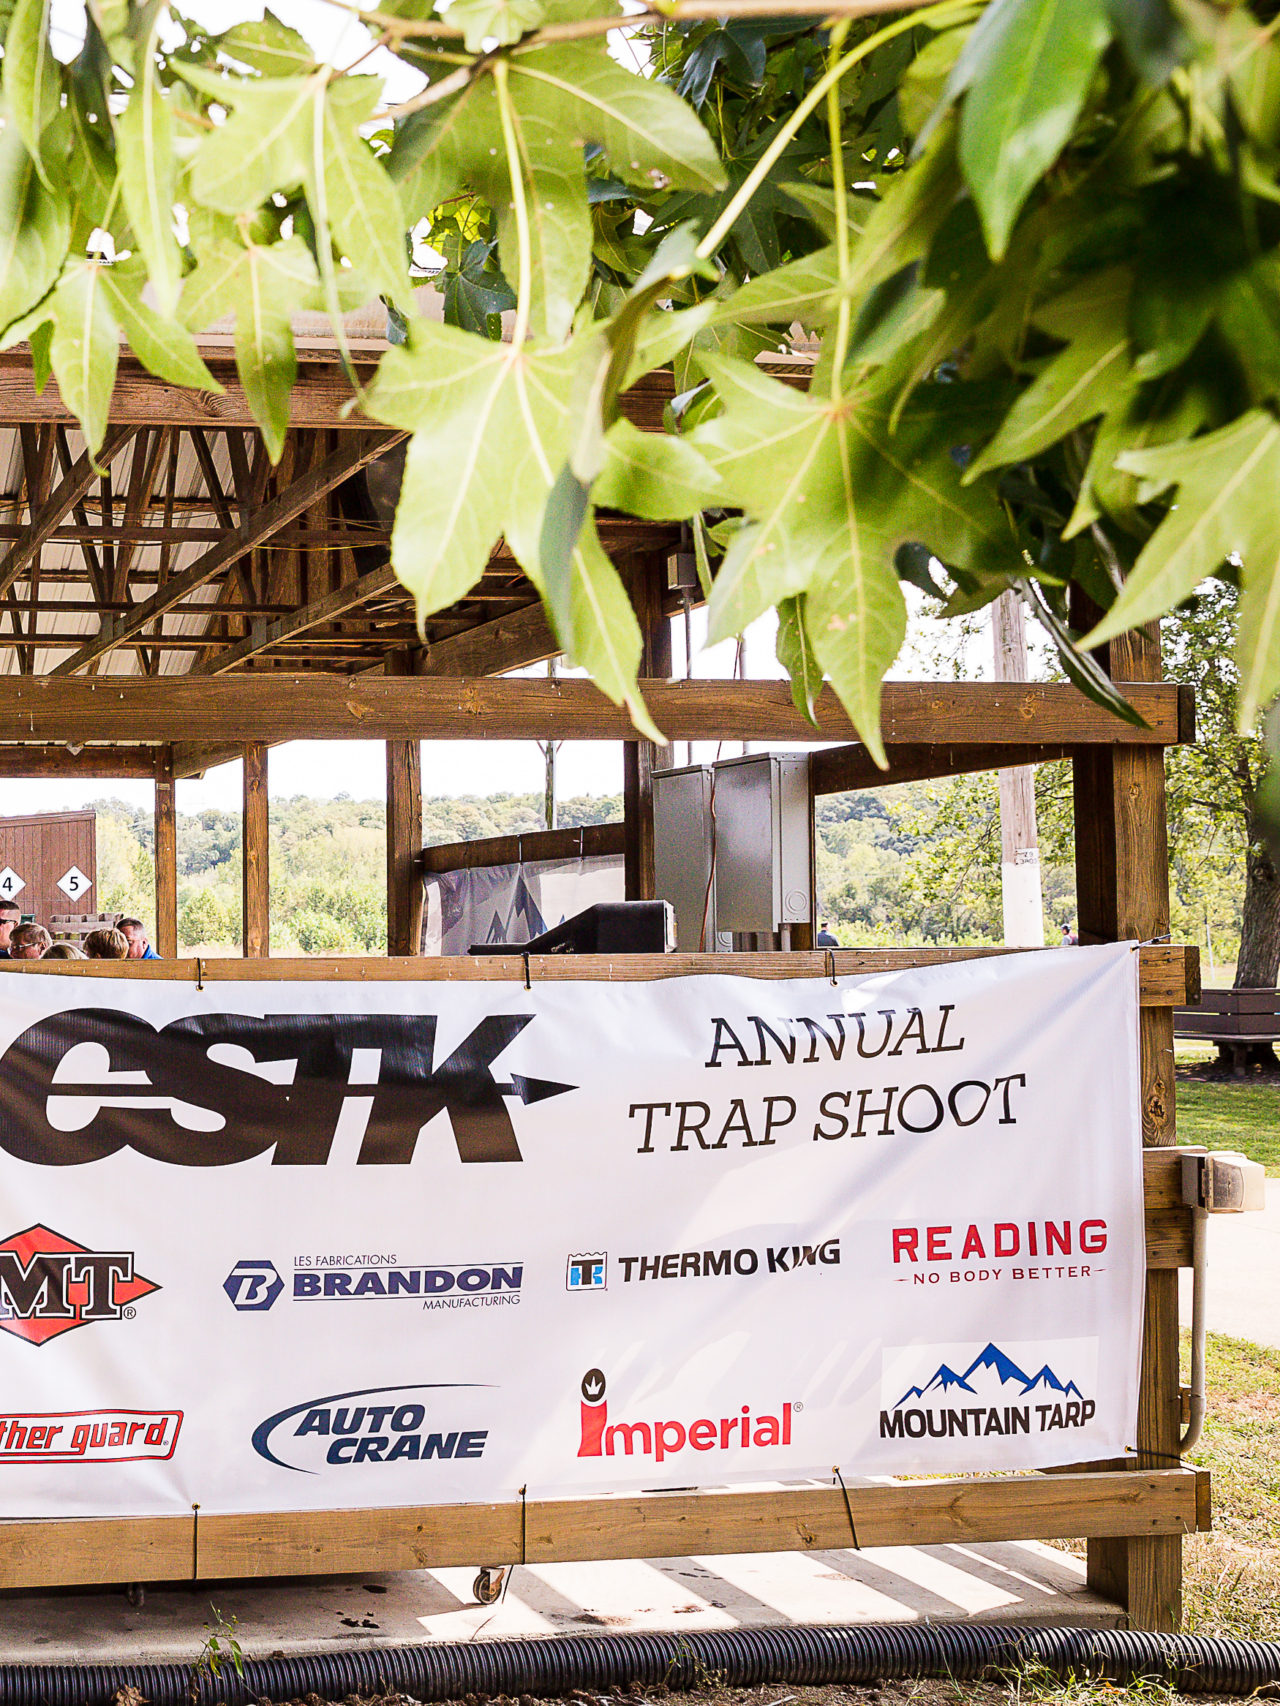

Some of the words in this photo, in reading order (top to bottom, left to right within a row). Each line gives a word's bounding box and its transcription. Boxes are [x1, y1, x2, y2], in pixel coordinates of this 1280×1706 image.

[2, 877, 13, 892] 4
[69, 876, 79, 891] 5
[705, 1004, 965, 1068] ANNUAL
[628, 1096, 797, 1154] TRAP
[813, 1073, 1026, 1142] SHOOT
[892, 1219, 1108, 1264] READING
[294, 1256, 312, 1267] LES
[316, 1254, 397, 1266] FABRICATIONS
[618, 1248, 759, 1282] THERMO
[766, 1238, 841, 1273] KING
[913, 1273, 940, 1285] NO
[950, 1269, 1002, 1283] BODY
[1012, 1265, 1091, 1280] BETTER
[293, 1266, 524, 1297] BRANDON
[422, 1294, 521, 1310] MANUFACTURING
[293, 1404, 426, 1437] AUTO
[879, 1406, 1030, 1438] MOUNTAIN
[1035, 1399, 1096, 1432] TARP
[70, 1417, 169, 1455] guard
[326, 1430, 489, 1465] CRANE
